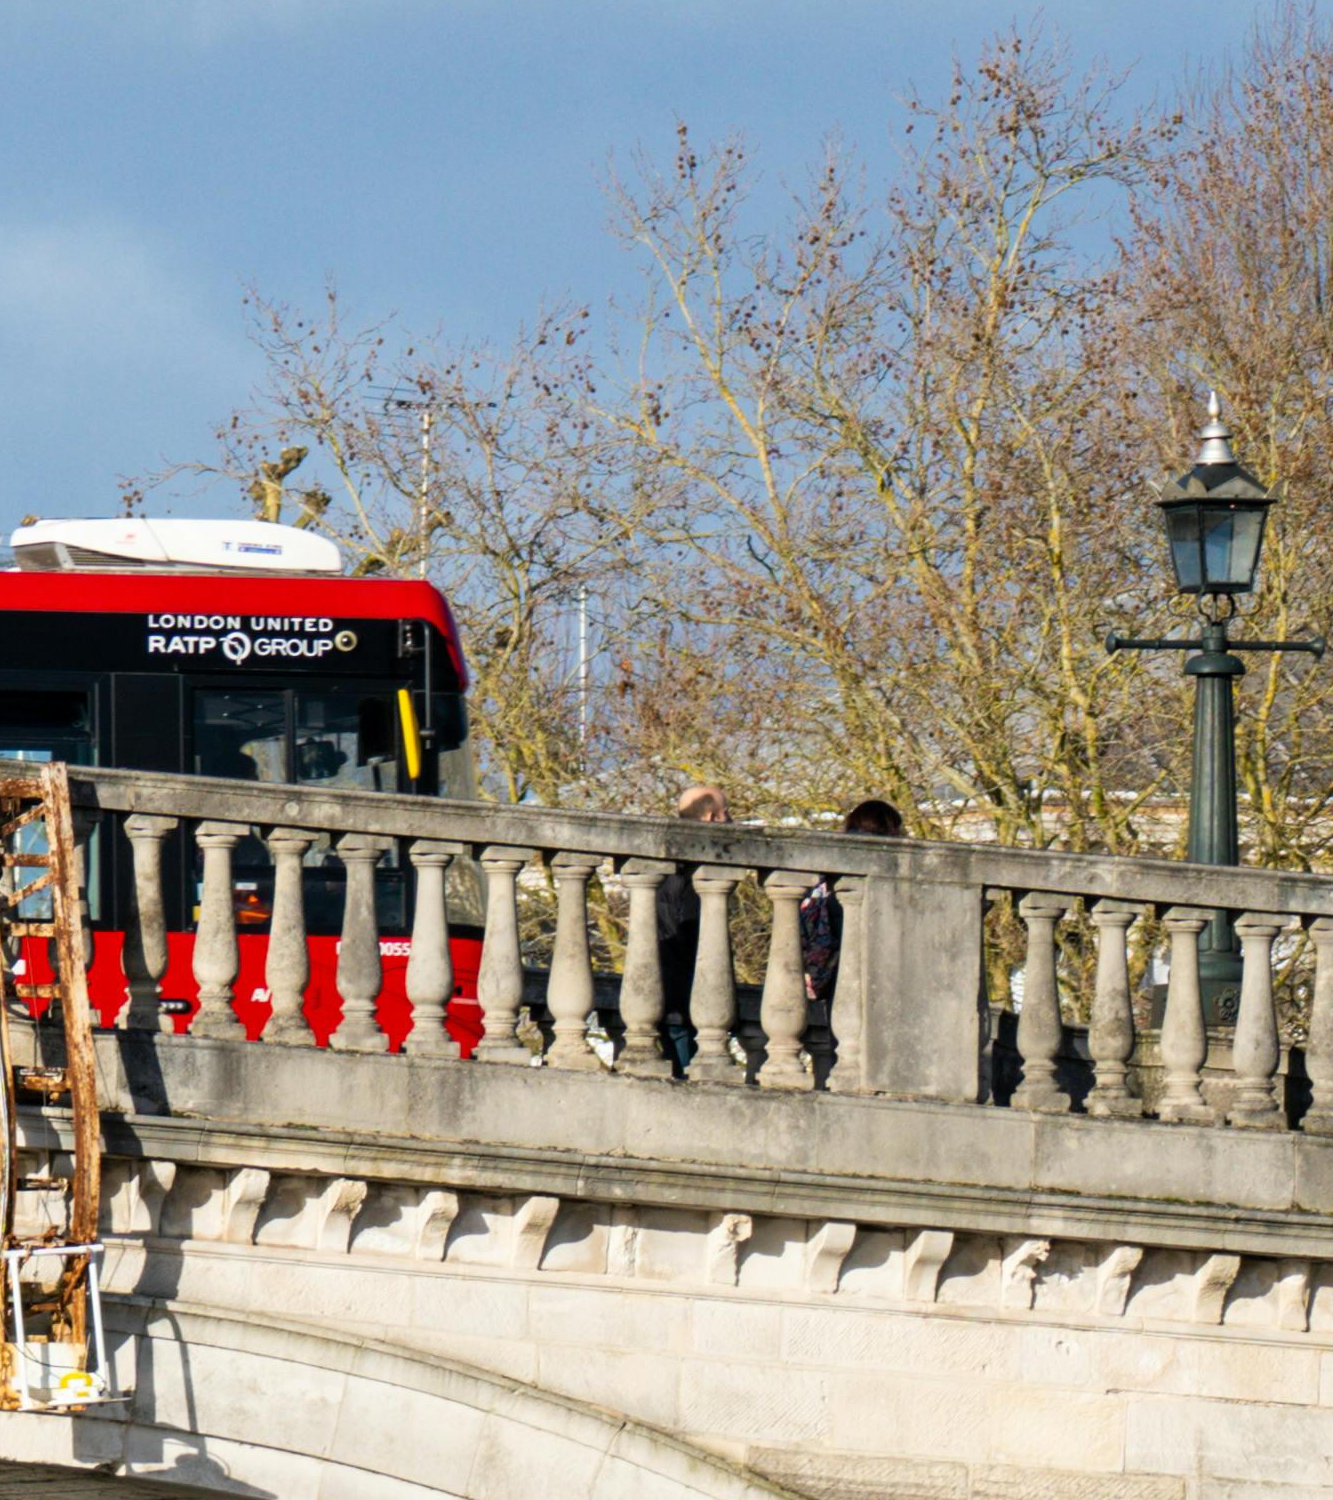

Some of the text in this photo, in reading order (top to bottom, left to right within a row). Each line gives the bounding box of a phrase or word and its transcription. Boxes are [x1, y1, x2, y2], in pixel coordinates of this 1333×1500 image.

[148, 614, 334, 632] LONDON UNITED
[148, 635, 334, 657] RATP GROUP
